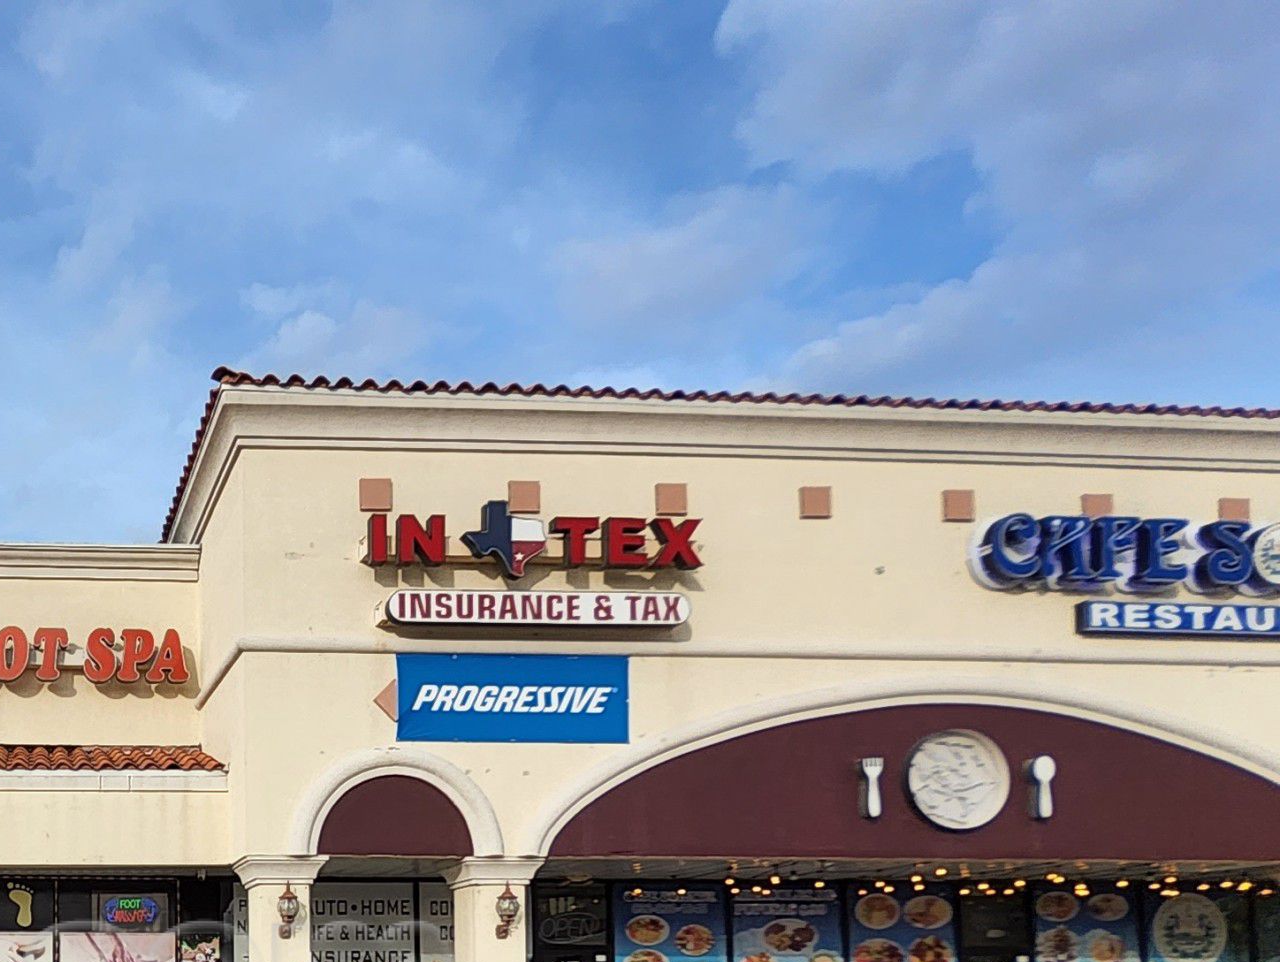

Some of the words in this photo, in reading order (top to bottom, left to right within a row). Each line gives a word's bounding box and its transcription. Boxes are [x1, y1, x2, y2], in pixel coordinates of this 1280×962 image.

[367, 513, 446, 566] IN
[549, 516, 704, 568] TEX
[397, 592, 581, 621] INSURANCE
[593, 595, 615, 621] &
[624, 595, 682, 622] TAX
[83, 627, 191, 684] SPA
[411, 684, 613, 714] PROGRESSIVE
[119, 898, 142, 909] FOOT
[361, 900, 411, 916] HOME
[312, 925, 335, 941] IFE
[339, 925, 349, 941] &
[355, 924, 411, 941] HEALTH
